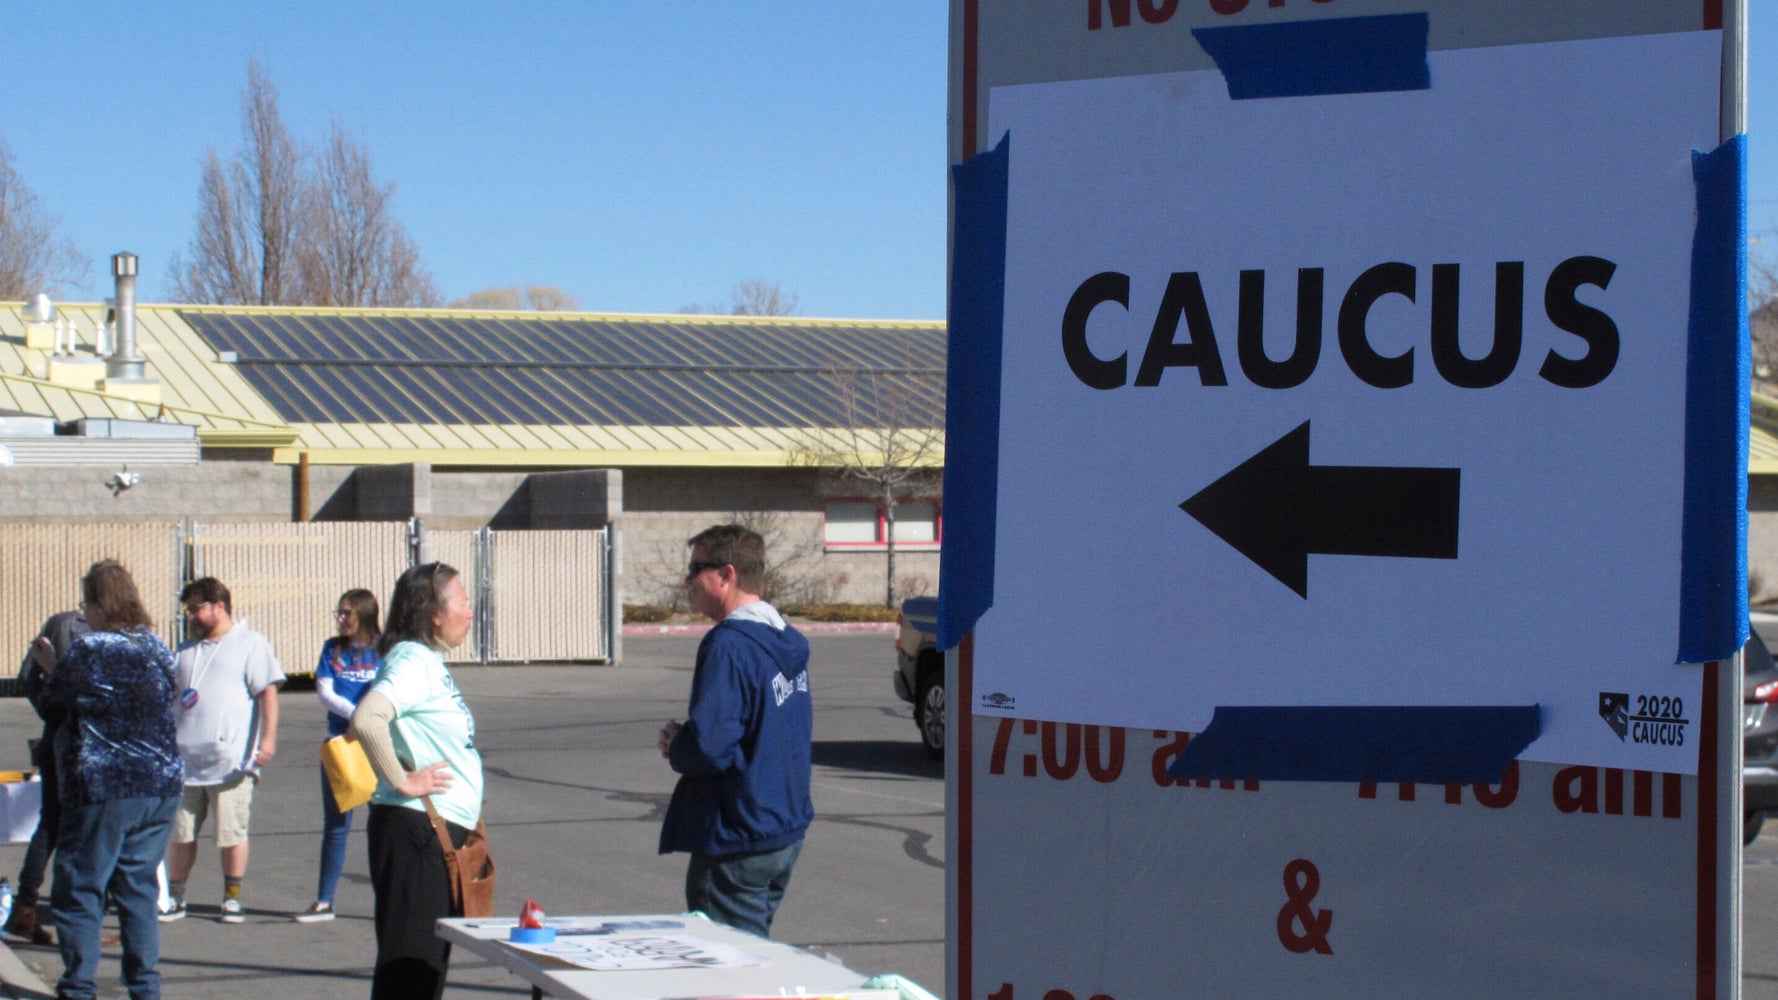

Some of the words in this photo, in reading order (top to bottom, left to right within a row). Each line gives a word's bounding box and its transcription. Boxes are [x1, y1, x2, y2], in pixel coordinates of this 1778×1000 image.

[1061, 255, 1621, 391] CAUCUS
[1632, 721, 1685, 747] CAUCUS
[1637, 694, 1684, 719] 2020
[1276, 858, 1334, 955] &
